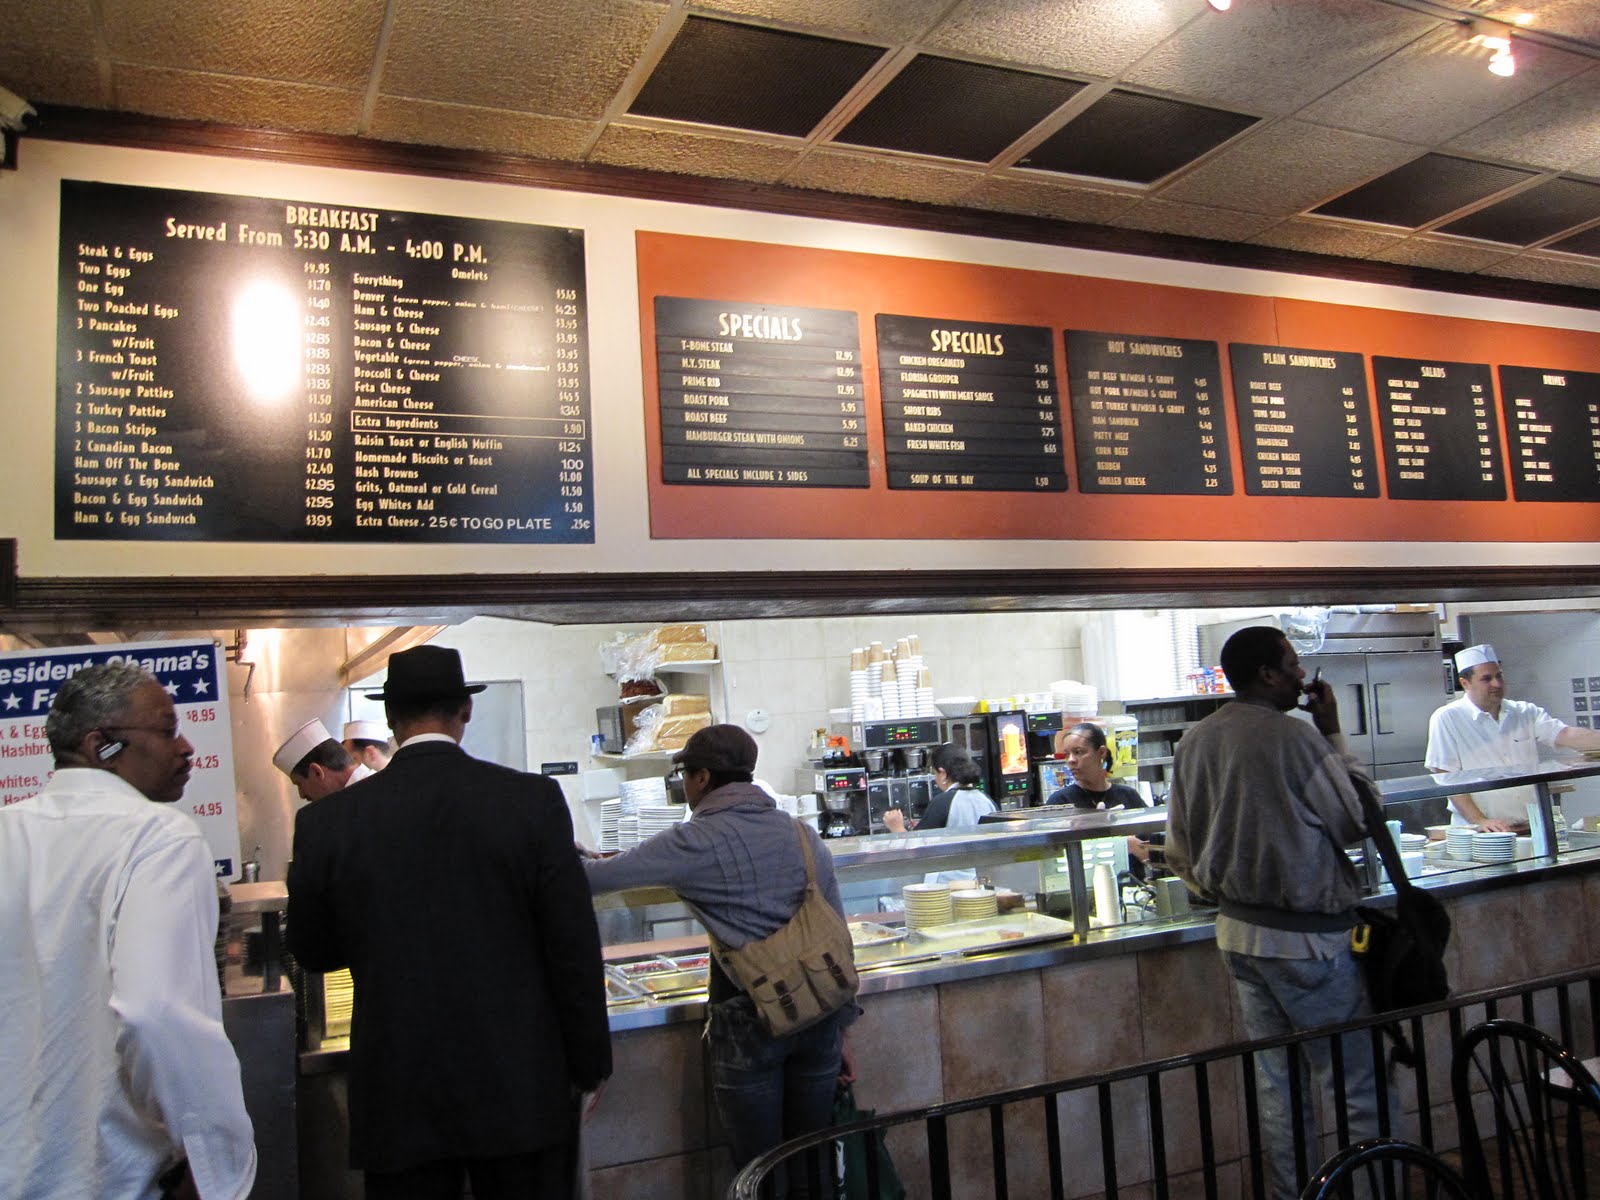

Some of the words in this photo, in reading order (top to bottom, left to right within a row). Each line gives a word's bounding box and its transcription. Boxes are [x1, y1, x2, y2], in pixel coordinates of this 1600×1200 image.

[286, 205, 379, 232] BREAKFAST
[166, 218, 226, 241] Served
[239, 224, 283, 246] From
[294, 229, 330, 250] 5:30
[340, 234, 376, 254] A.M.
[406, 239, 443, 260] 4:00
[453, 243, 488, 263] P.M.
[79, 244, 108, 258] Steak
[114, 247, 122, 258] &
[130, 249, 153, 261] Eggs
[79, 262, 100, 275] Two
[107, 264, 130, 278] Eggs
[452, 269, 488, 280] Omelets
[354, 273, 403, 289] Everything
[78, 281, 98, 292] One
[105, 282, 124, 296] Egg
[354, 290, 385, 302] Denver
[78, 299, 99, 312] Two
[106, 302, 147, 315] Poached
[155, 305, 178, 319] Eggs
[354, 306, 375, 318] Ham
[381, 307, 387, 317] &
[395, 308, 424, 319] Cheese
[77, 318, 82, 328] 3
[90, 320, 137, 332] Pancakes
[354, 320, 391, 333] Sausage
[397, 322, 404, 332] &
[410, 323, 439, 336] Cheese
[719, 313, 802, 341] SPECIALS
[113, 337, 154, 349] w/Fruit
[354, 336, 381, 348] Bacon
[387, 338, 394, 348] &
[401, 339, 430, 350] Cheese
[682, 340, 710, 352] T-BONE
[712, 343, 733, 353] STEAK
[931, 330, 1004, 355] SPECIALS
[1108, 341, 1125, 353] HOT
[1129, 342, 1182, 357] SANDWICHES
[77, 350, 82, 361] 3
[89, 352, 123, 364] French
[130, 353, 157, 365] Toast
[355, 351, 399, 365] Vegetable
[682, 359, 697, 369] N.Y.
[698, 359, 720, 369] STEAK
[1263, 353, 1286, 364] PLAIN
[1289, 355, 1336, 368] SANDWICHES
[112, 370, 154, 382] w/Fruit
[355, 367, 391, 379] Broccoli
[397, 369, 404, 379] &
[410, 370, 439, 382] Cheese
[901, 373, 928, 383] FLORIDA
[929, 374, 959, 384] GROUPER
[355, 382, 375, 393] Feta
[381, 382, 411, 394] Cheese
[682, 376, 706, 387] PRIME
[707, 378, 720, 387] RIB
[76, 384, 82, 394] 2
[89, 385, 130, 398] Sausage
[137, 386, 174, 399] Patties
[309, 394, 331, 405] $1.50
[355, 396, 398, 408] American
[404, 398, 433, 410] Cheese
[684, 395, 708, 405] ROAST
[709, 396, 729, 406] PORK
[76, 403, 81, 414] 2
[88, 404, 123, 418] Turkey
[130, 405, 166, 418] Patties
[308, 413, 331, 424] $1.50
[355, 416, 380, 428] Extra
[387, 417, 438, 430] Ingredients
[685, 413, 709, 422] ROAST
[710, 414, 727, 424] BEEF
[75, 421, 81, 432] 3
[88, 423, 119, 434] Bacon
[126, 423, 156, 436] Strips
[308, 431, 332, 441] $1.50
[355, 434, 383, 446] Raisin
[390, 437, 412, 447] Toast
[435, 437, 468, 450] English
[473, 440, 502, 450] Muffin
[75, 441, 81, 451] 2
[88, 441, 134, 453] Canadian
[142, 442, 172, 454] Bacon
[307, 448, 331, 459] $1.70
[75, 457, 98, 469] Ham
[106, 458, 123, 469] Off
[129, 458, 147, 470] The
[155, 460, 179, 470] Bone
[355, 451, 407, 463] Homemade
[412, 453, 449, 464] Biscuits
[454, 457, 464, 465] or
[469, 454, 492, 465] Toast
[307, 463, 334, 474] $2.40
[356, 467, 379, 478] Hash
[384, 467, 418, 479] Browns
[688, 468, 701, 479] ALL
[705, 470, 738, 479] SPECIALS
[743, 471, 774, 480] INCLUDE
[778, 472, 783, 480] 2
[787, 472, 807, 481] SIDES
[75, 474, 117, 488] Sausage
[124, 475, 132, 485] &
[140, 476, 158, 489] Egg
[165, 476, 213, 488] Sandwich
[560, 472, 581, 482] $1.00
[911, 475, 929, 484] SOUP
[933, 475, 941, 483] OF
[945, 475, 958, 484] THE
[962, 476, 974, 484] DAY
[356, 482, 382, 495] Grits,
[389, 483, 427, 494] Oatmeal
[432, 486, 442, 494] or
[448, 483, 466, 494] Cold
[472, 484, 497, 495] Cereal
[561, 486, 582, 496] $1.50
[74, 493, 106, 504] Bacon
[113, 494, 121, 504] &
[128, 494, 147, 506] Egg
[154, 494, 203, 505] Sandwich
[356, 499, 373, 511] Egg
[379, 500, 411, 510] Whites
[417, 500, 433, 510] Add
[75, 512, 98, 523] Ham
[105, 512, 114, 523] &
[121, 514, 140, 525] Egg
[147, 513, 196, 524] Sandwich
[357, 516, 382, 526] Extra
[507, 518, 551, 529] PLATE
[187, 708, 215, 722] $8.95
[10, 725, 18, 739] &
[193, 802, 222, 816] $4.95
